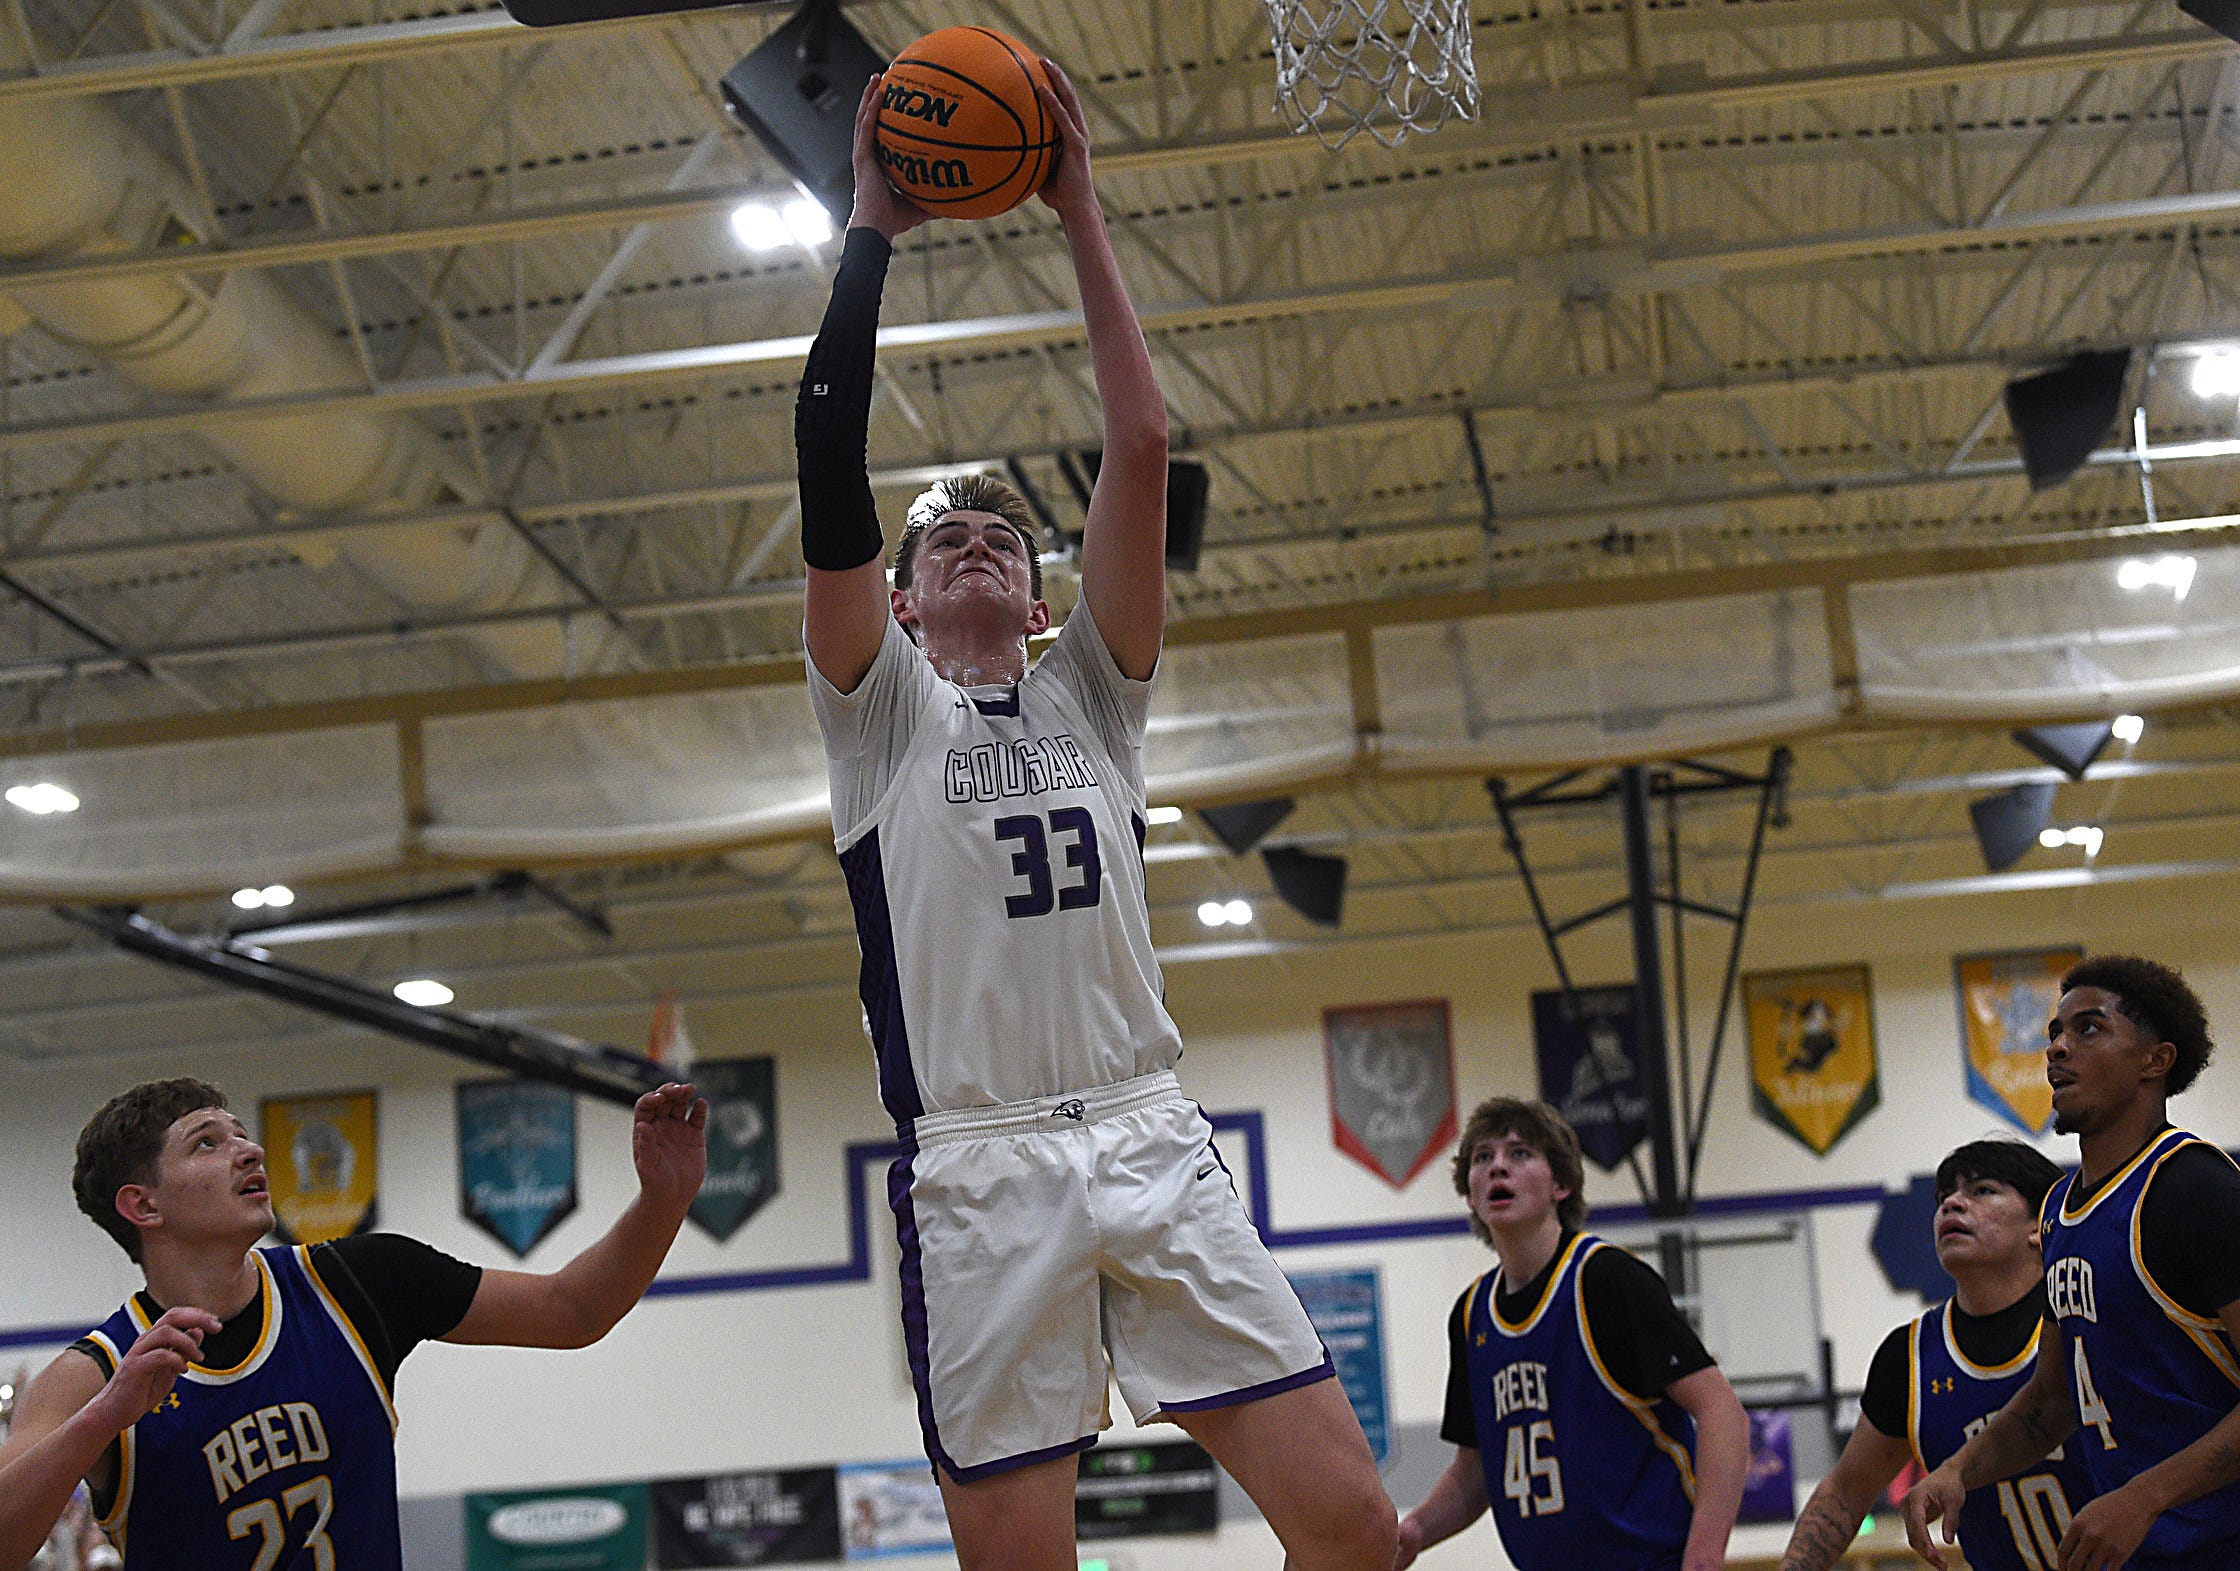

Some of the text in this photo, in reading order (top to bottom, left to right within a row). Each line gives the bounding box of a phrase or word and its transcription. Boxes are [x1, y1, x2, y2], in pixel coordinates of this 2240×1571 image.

[883, 82, 960, 128] NCAA
[881, 143, 973, 187] Wilso
[945, 734, 1099, 803] COUGAR
[994, 806, 1101, 918] 33
[2046, 1256, 2097, 1327] REED
[2074, 1335, 2118, 1450] 4
[201, 1402, 330, 1505] REED
[1504, 1420, 1565, 1518] 45
[1997, 1473, 2073, 1571] 10
